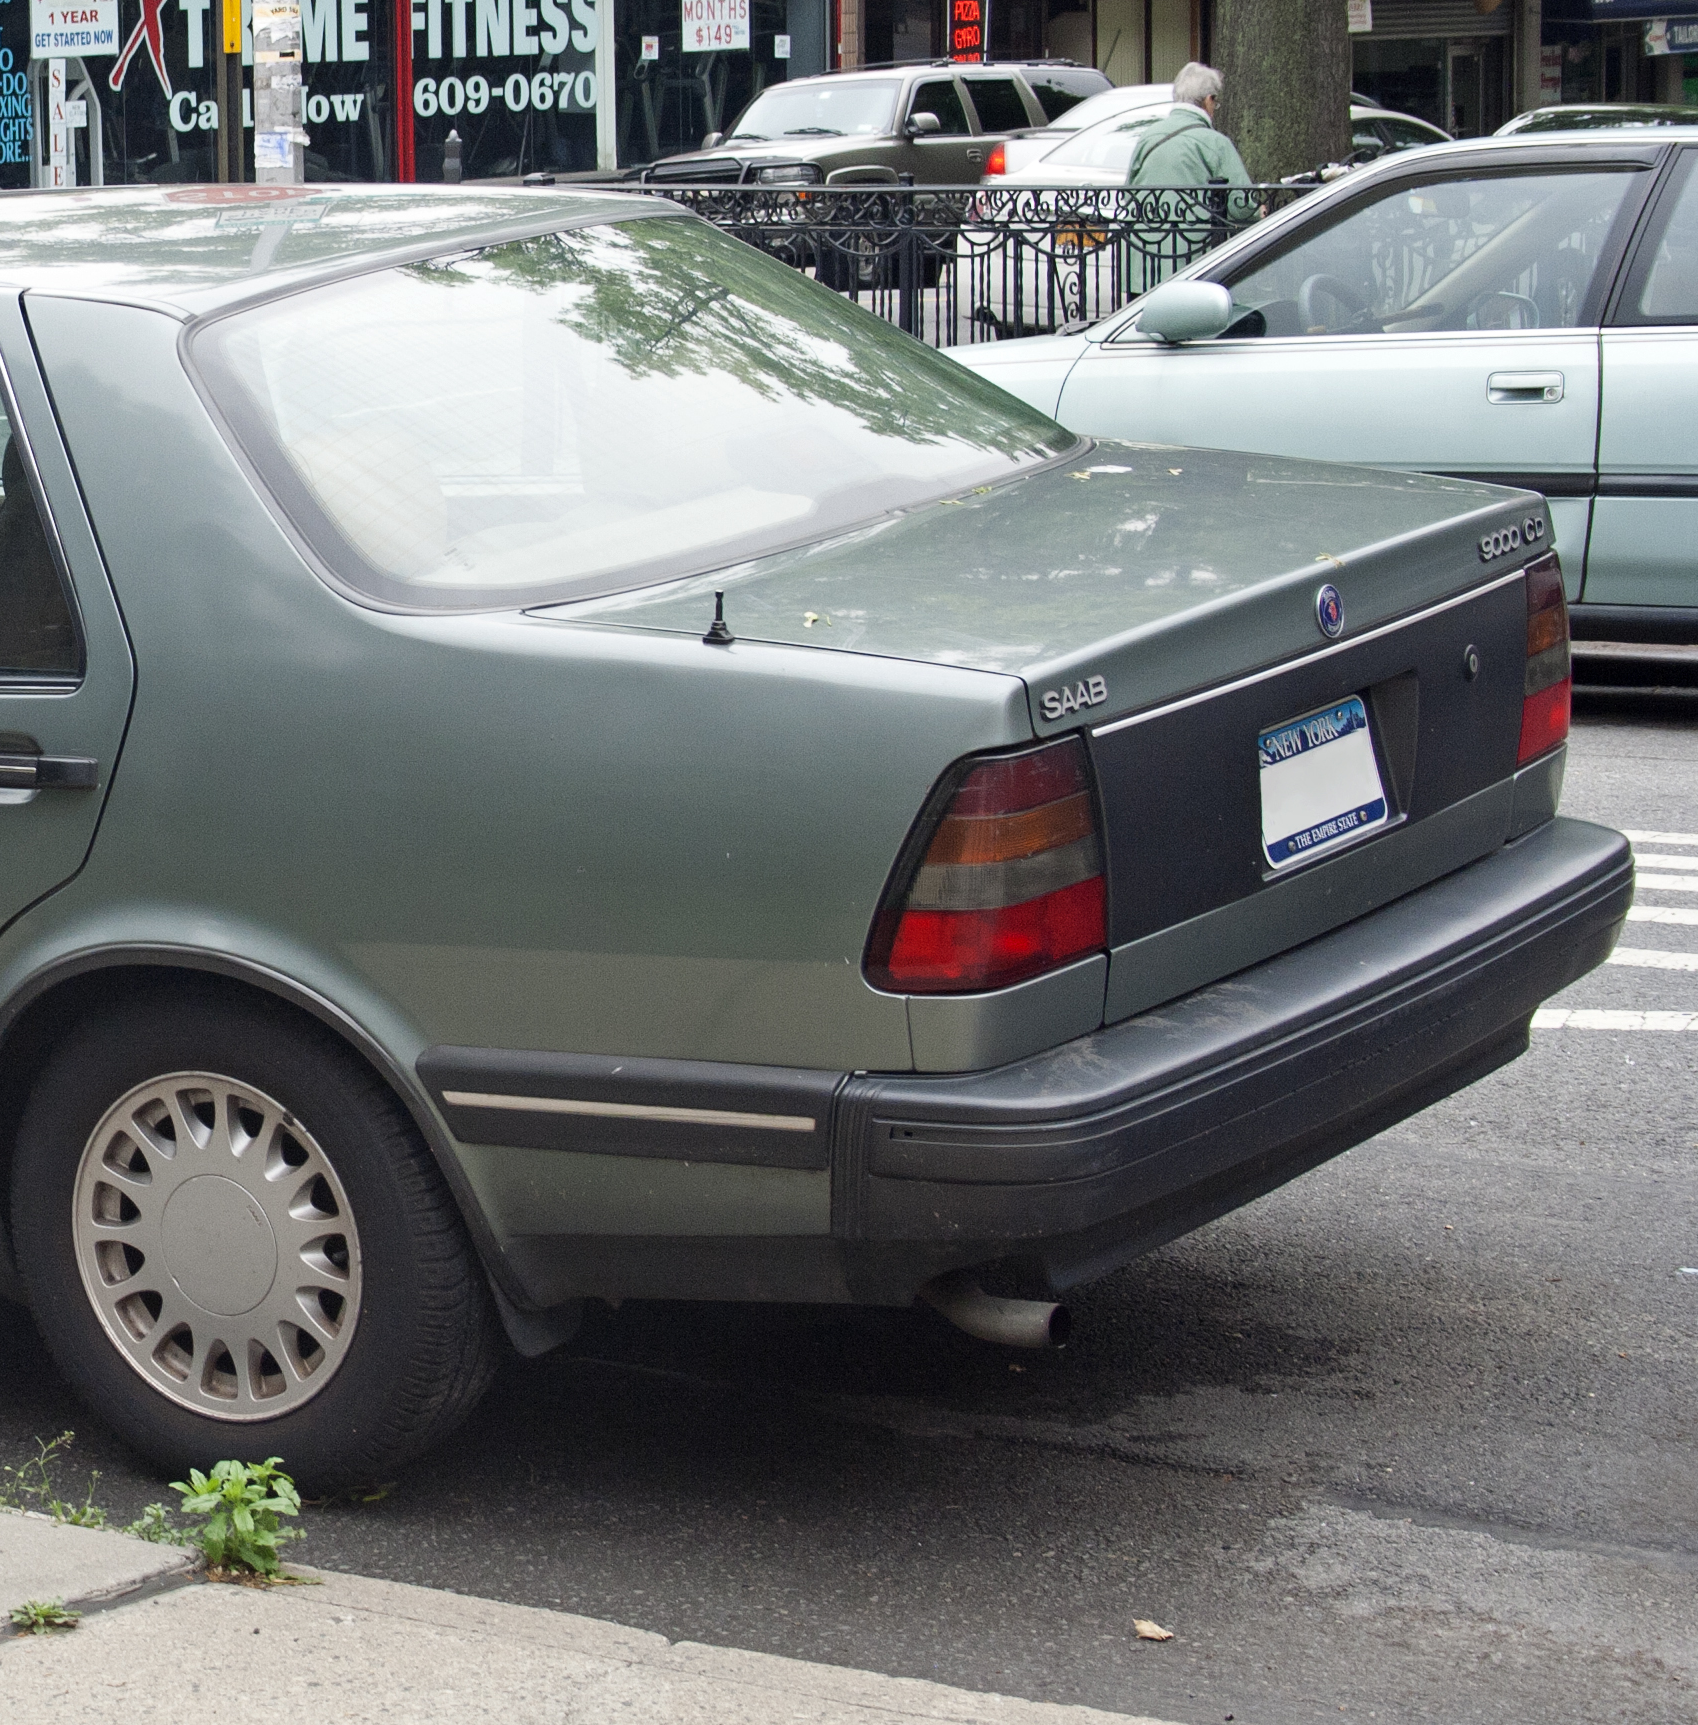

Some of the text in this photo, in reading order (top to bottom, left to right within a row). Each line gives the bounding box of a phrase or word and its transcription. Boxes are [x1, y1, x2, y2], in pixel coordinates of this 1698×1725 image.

[48, 10, 99, 25] 1 YEAR
[683, 0, 747, 22] MONTHS
[954, 0, 980, 20] PIZZA
[35, 29, 113, 48] GET STARTED NOW
[109, 0, 599, 100] XTME FITNESS
[696, 24, 732, 46] $149
[954, 25, 980, 49] GYRO
[169, 86, 364, 132] Cal ow
[413, 70, 599, 117] 609-0670
[1480, 517, 1545, 560] 9000 CD
[1041, 674, 1108, 719] SAAB
[1271, 715, 1339, 760] NEW YORK
[1295, 812, 1359, 849] THE EMPIRE STATE
